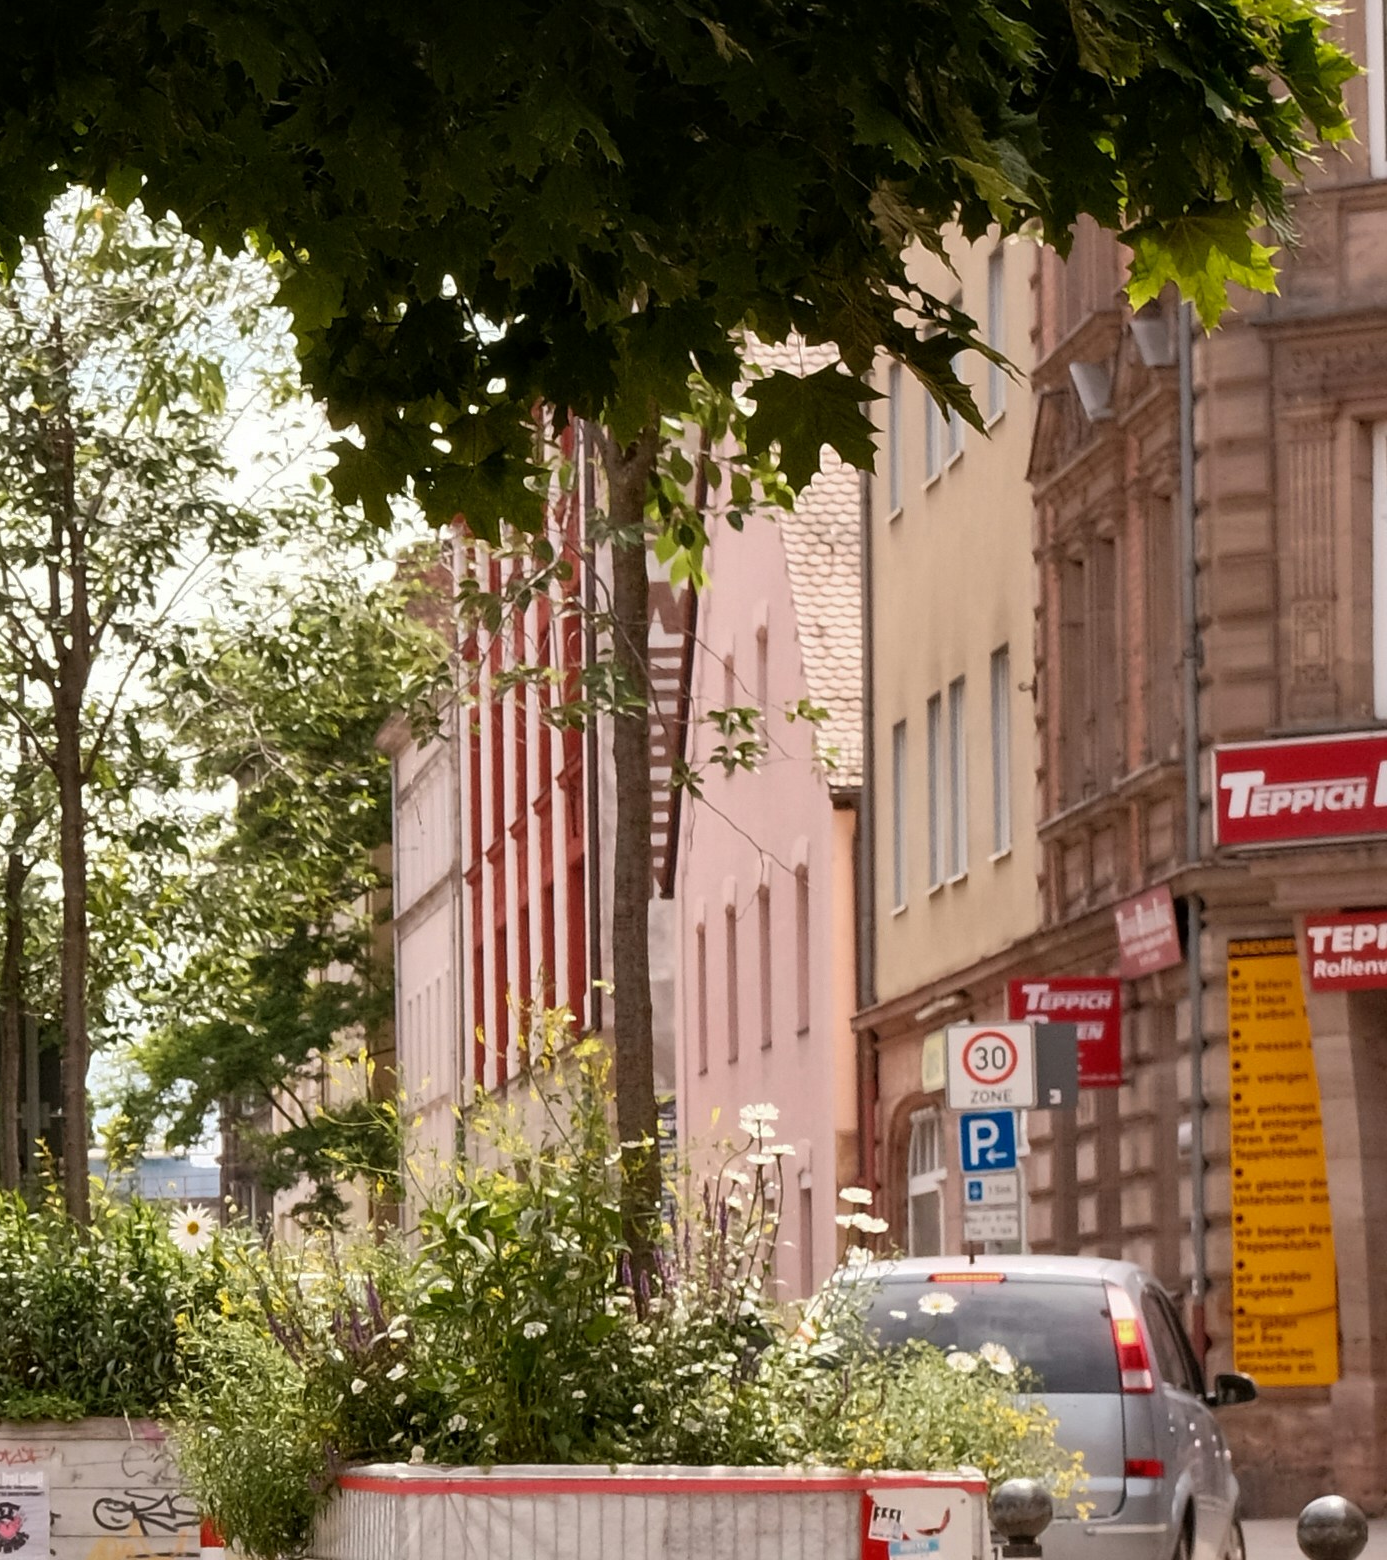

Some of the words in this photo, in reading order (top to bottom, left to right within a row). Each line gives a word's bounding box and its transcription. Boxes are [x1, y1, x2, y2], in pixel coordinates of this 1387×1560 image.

[1220, 770, 1368, 819] TEPPICH
[1022, 983, 1112, 1011] TEPPICH
[975, 1046, 1006, 1071] 30
[970, 1088, 1012, 1105] ZONE
[969, 1119, 999, 1167] P
